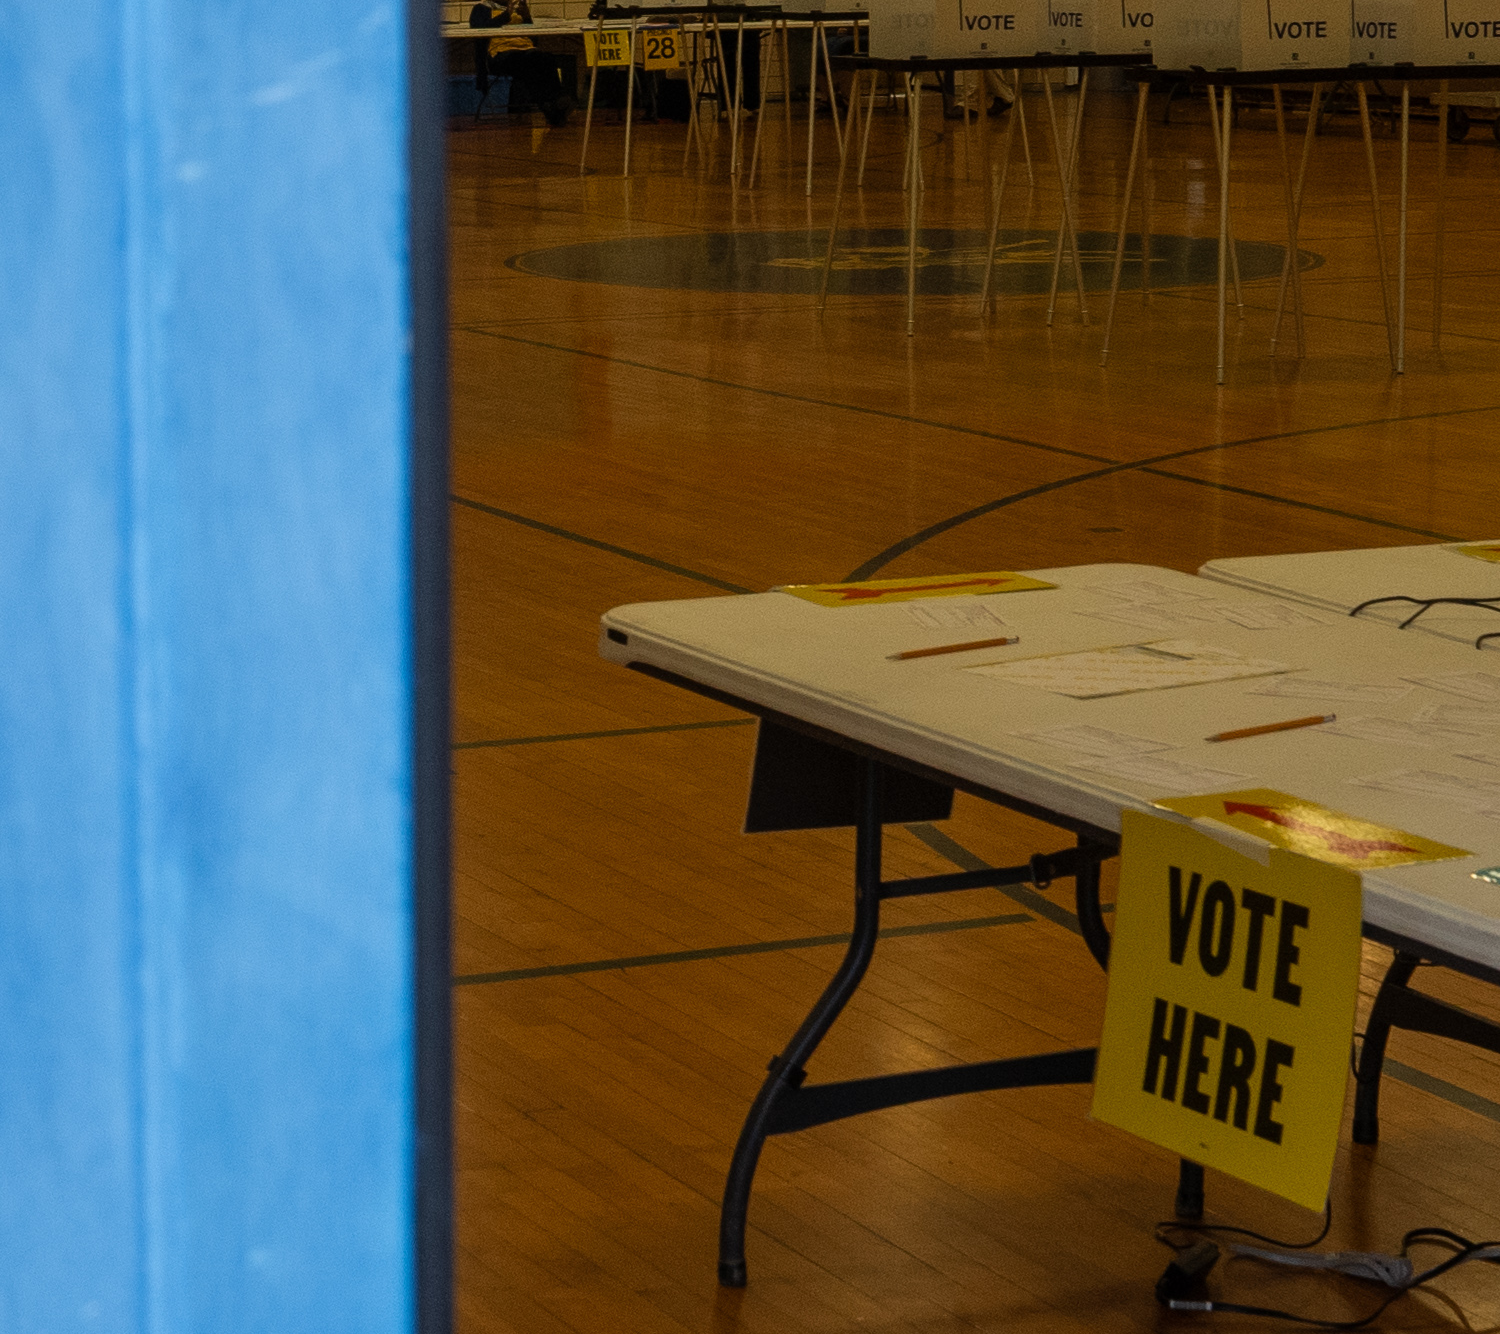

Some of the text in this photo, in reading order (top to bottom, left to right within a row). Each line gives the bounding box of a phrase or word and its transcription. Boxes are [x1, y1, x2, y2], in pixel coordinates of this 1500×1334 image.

[965, 15, 1015, 30] VOTE
[1052, 13, 1083, 27] VOTE
[1127, 13, 1154, 27] VO
[1274, 21, 1327, 38] VOTE
[1356, 22, 1397, 38] VOTE
[647, 37, 675, 59] 28
[1168, 865, 1310, 1008] VOTE
[1141, 997, 1296, 1145] HERE
